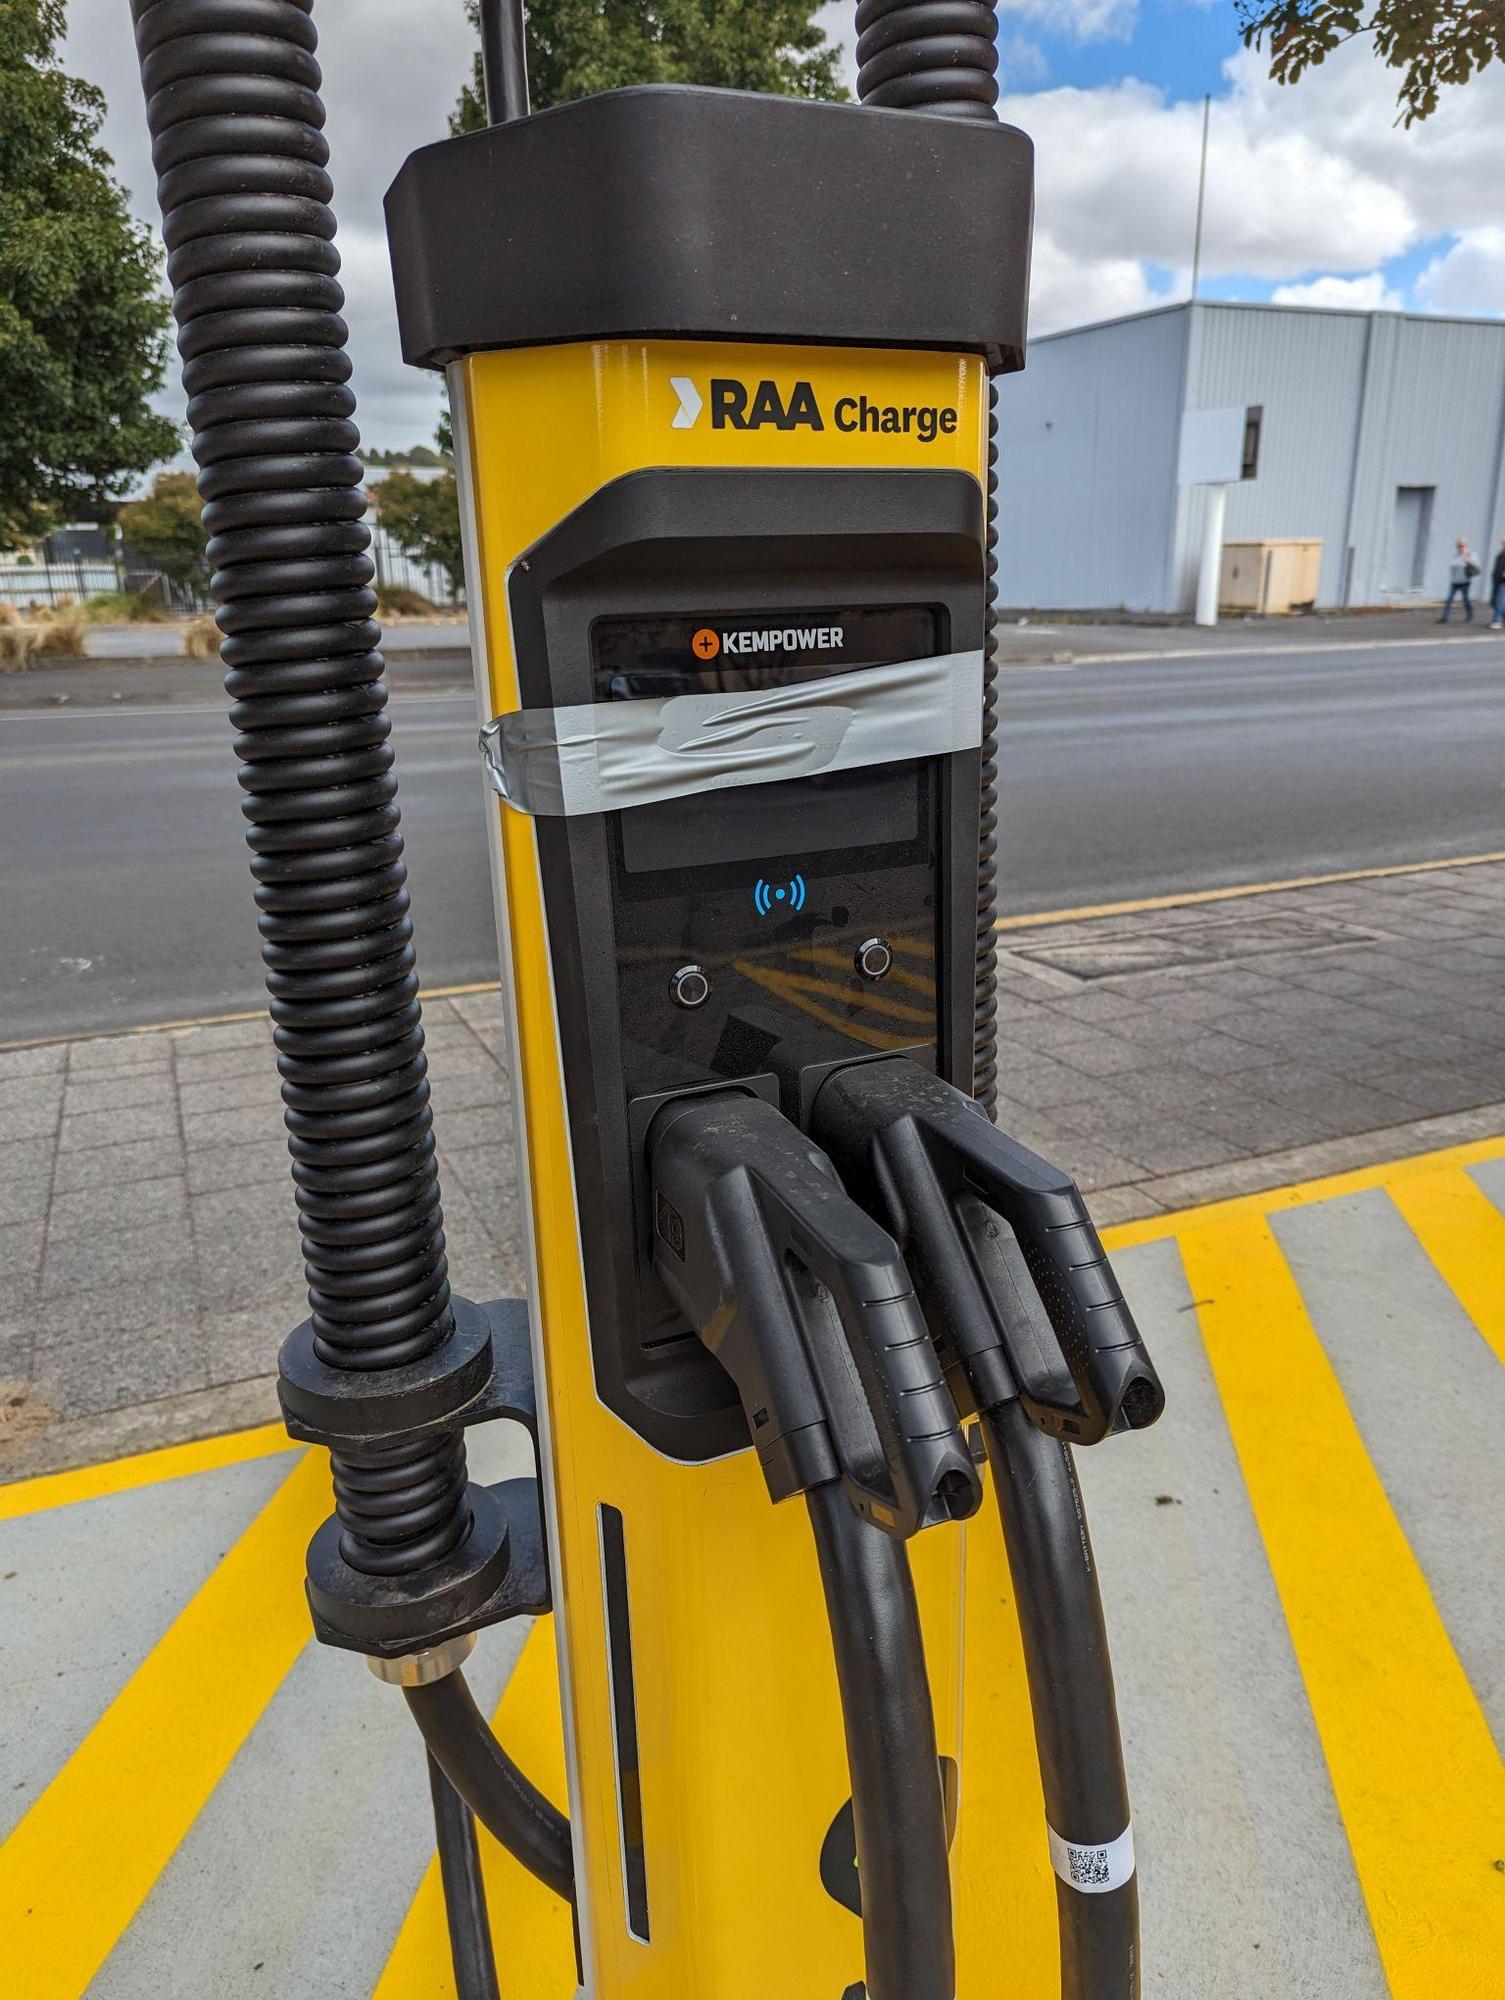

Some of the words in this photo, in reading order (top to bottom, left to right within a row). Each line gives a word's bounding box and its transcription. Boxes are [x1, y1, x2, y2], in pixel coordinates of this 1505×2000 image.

[710, 379, 824, 431] RAA
[834, 396, 957, 443] Charge
[722, 627, 844, 654] KEMPOWER
